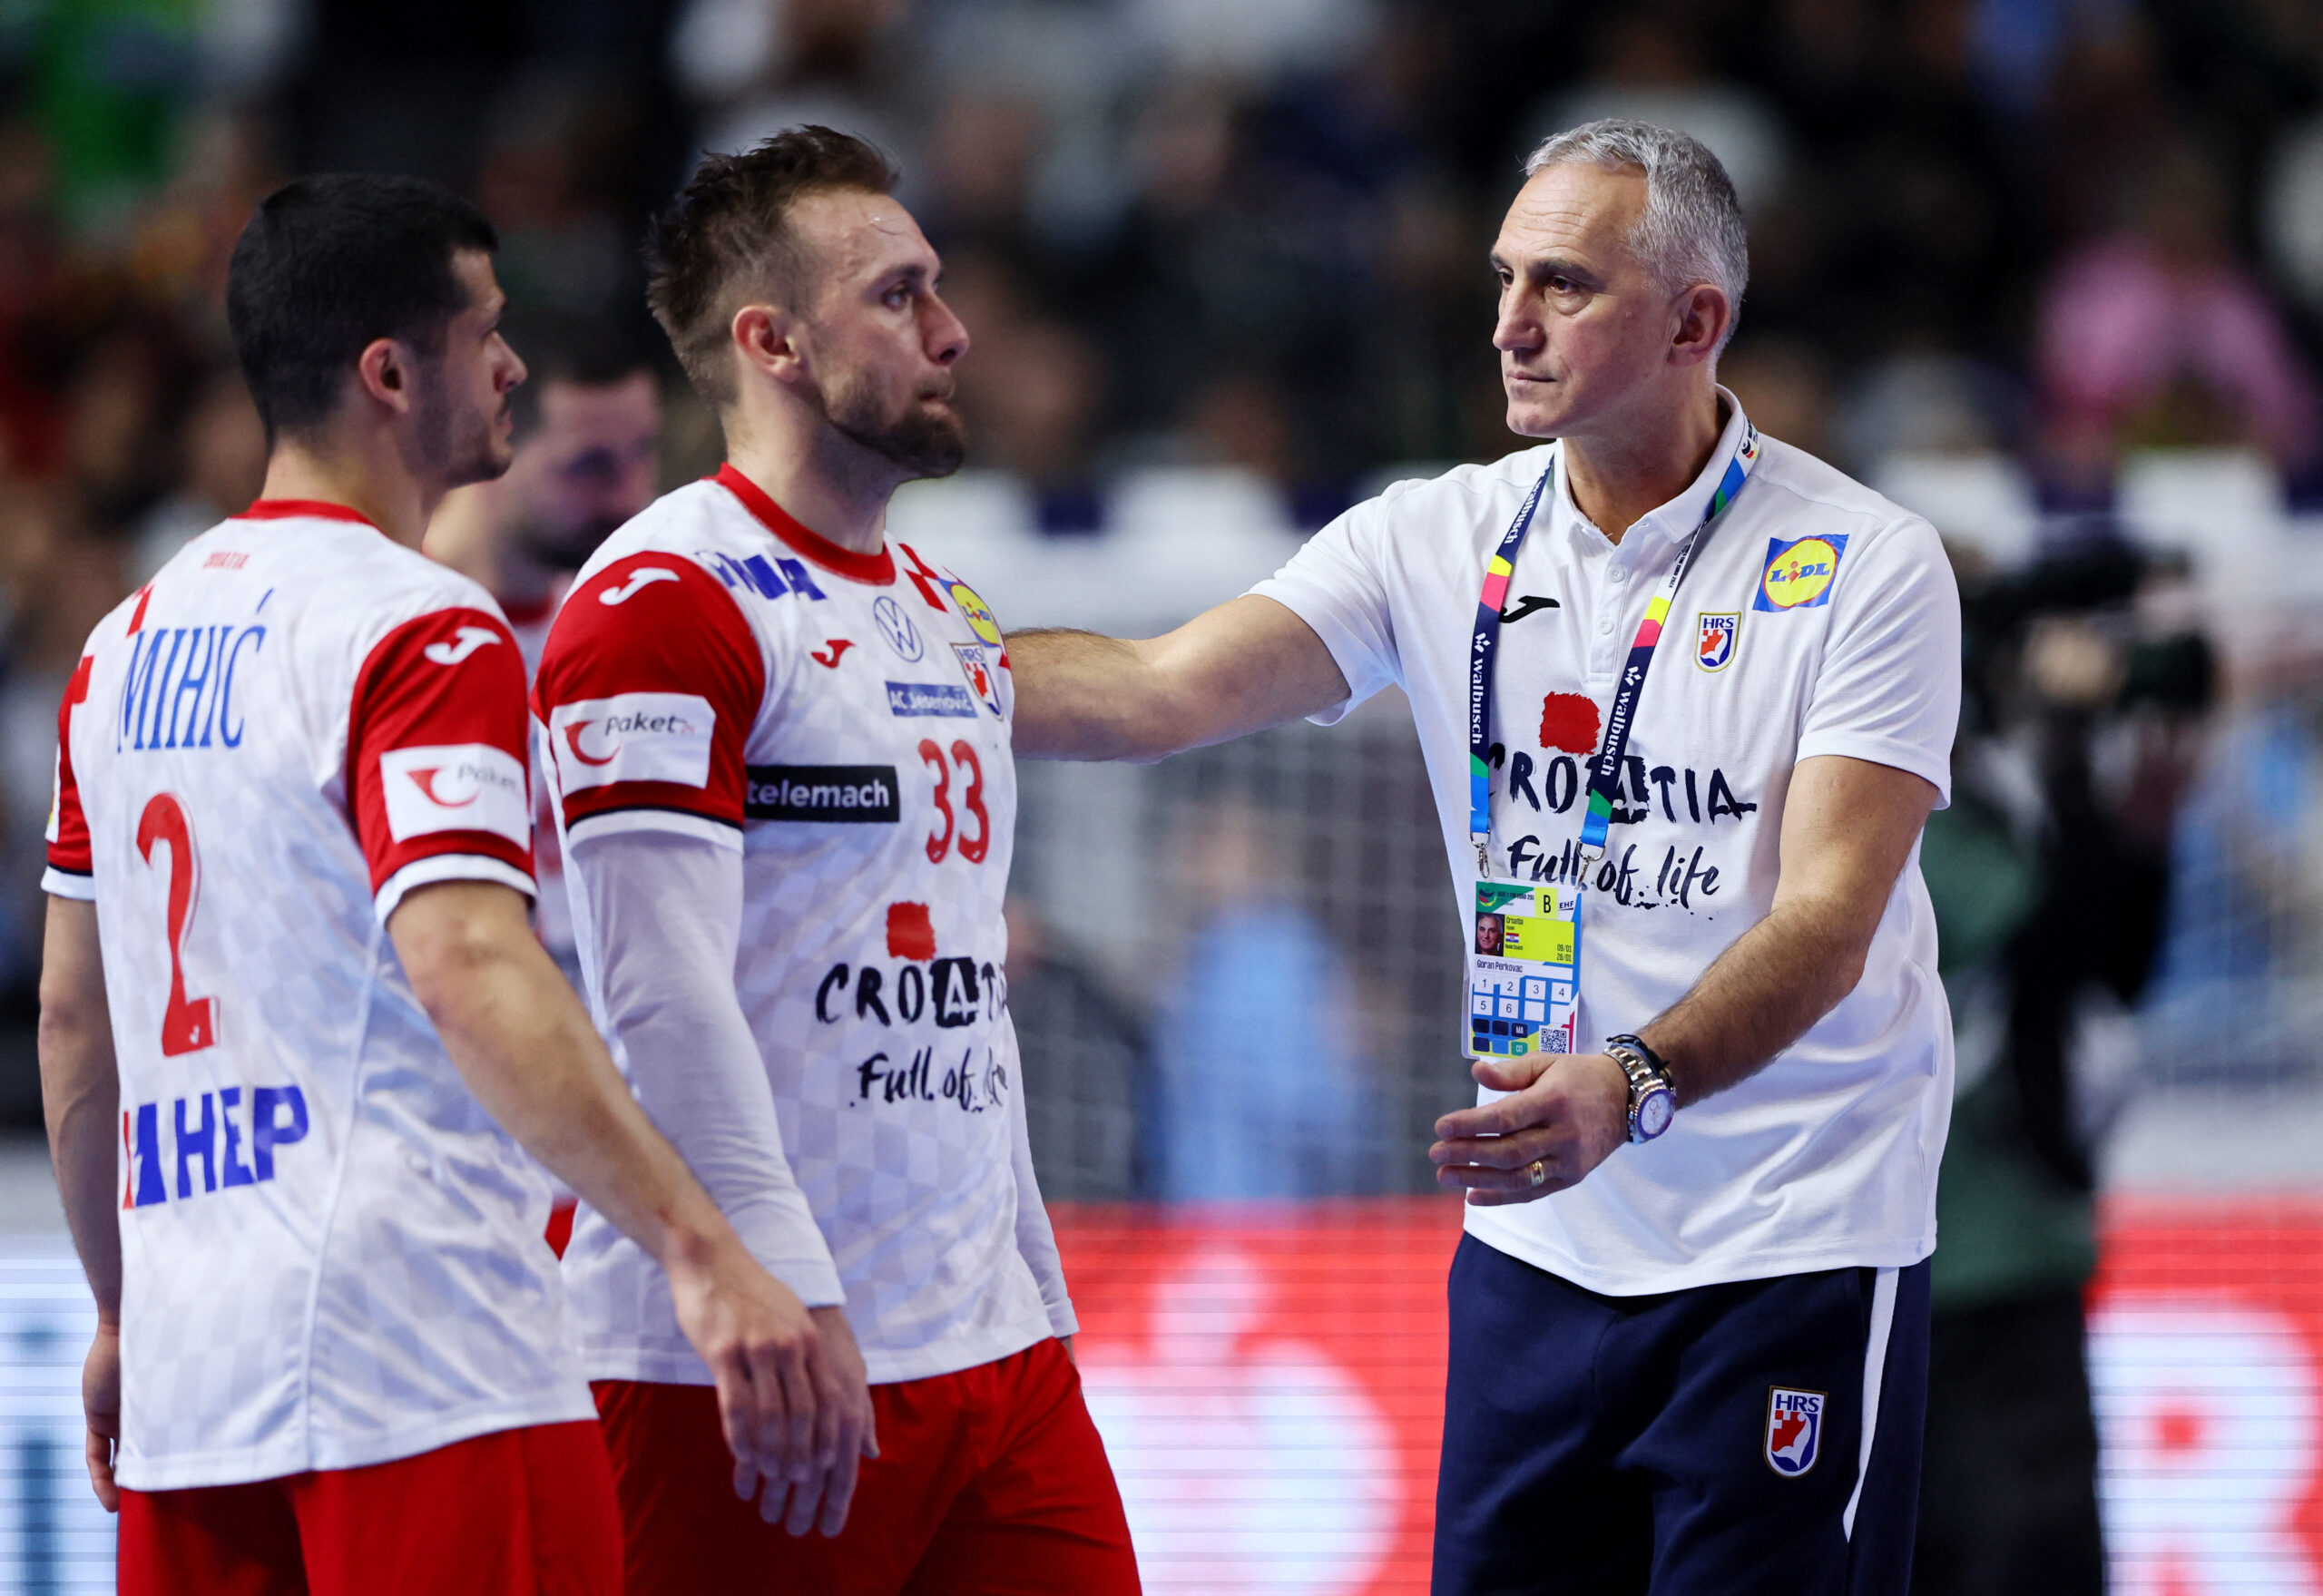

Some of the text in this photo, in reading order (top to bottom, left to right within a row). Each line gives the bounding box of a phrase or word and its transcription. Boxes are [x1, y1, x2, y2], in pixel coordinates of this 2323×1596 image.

[1504, 479, 1543, 544] walbusch
[1702, 617, 1735, 629] HRS
[117, 588, 275, 754] MIHIĆ
[956, 647, 985, 661] HRS
[1472, 658, 1485, 745] walbusch
[1600, 690, 1632, 777] walbusch
[747, 778, 890, 808] telemach
[916, 739, 991, 865] 33
[1506, 835, 1720, 909] Full of life
[136, 791, 221, 1057] 2
[1543, 895, 1552, 914] B
[1559, 900, 1574, 909] EHF
[1476, 959, 1524, 974] Goran Perkovac
[1482, 978, 1565, 997] 1 2 3 4
[1480, 1000, 1513, 1013] 5 6
[857, 1044, 935, 1104] Full
[942, 1047, 975, 1112] of
[175, 1084, 309, 1199] HEP
[1775, 1394, 1820, 1413] HRS
